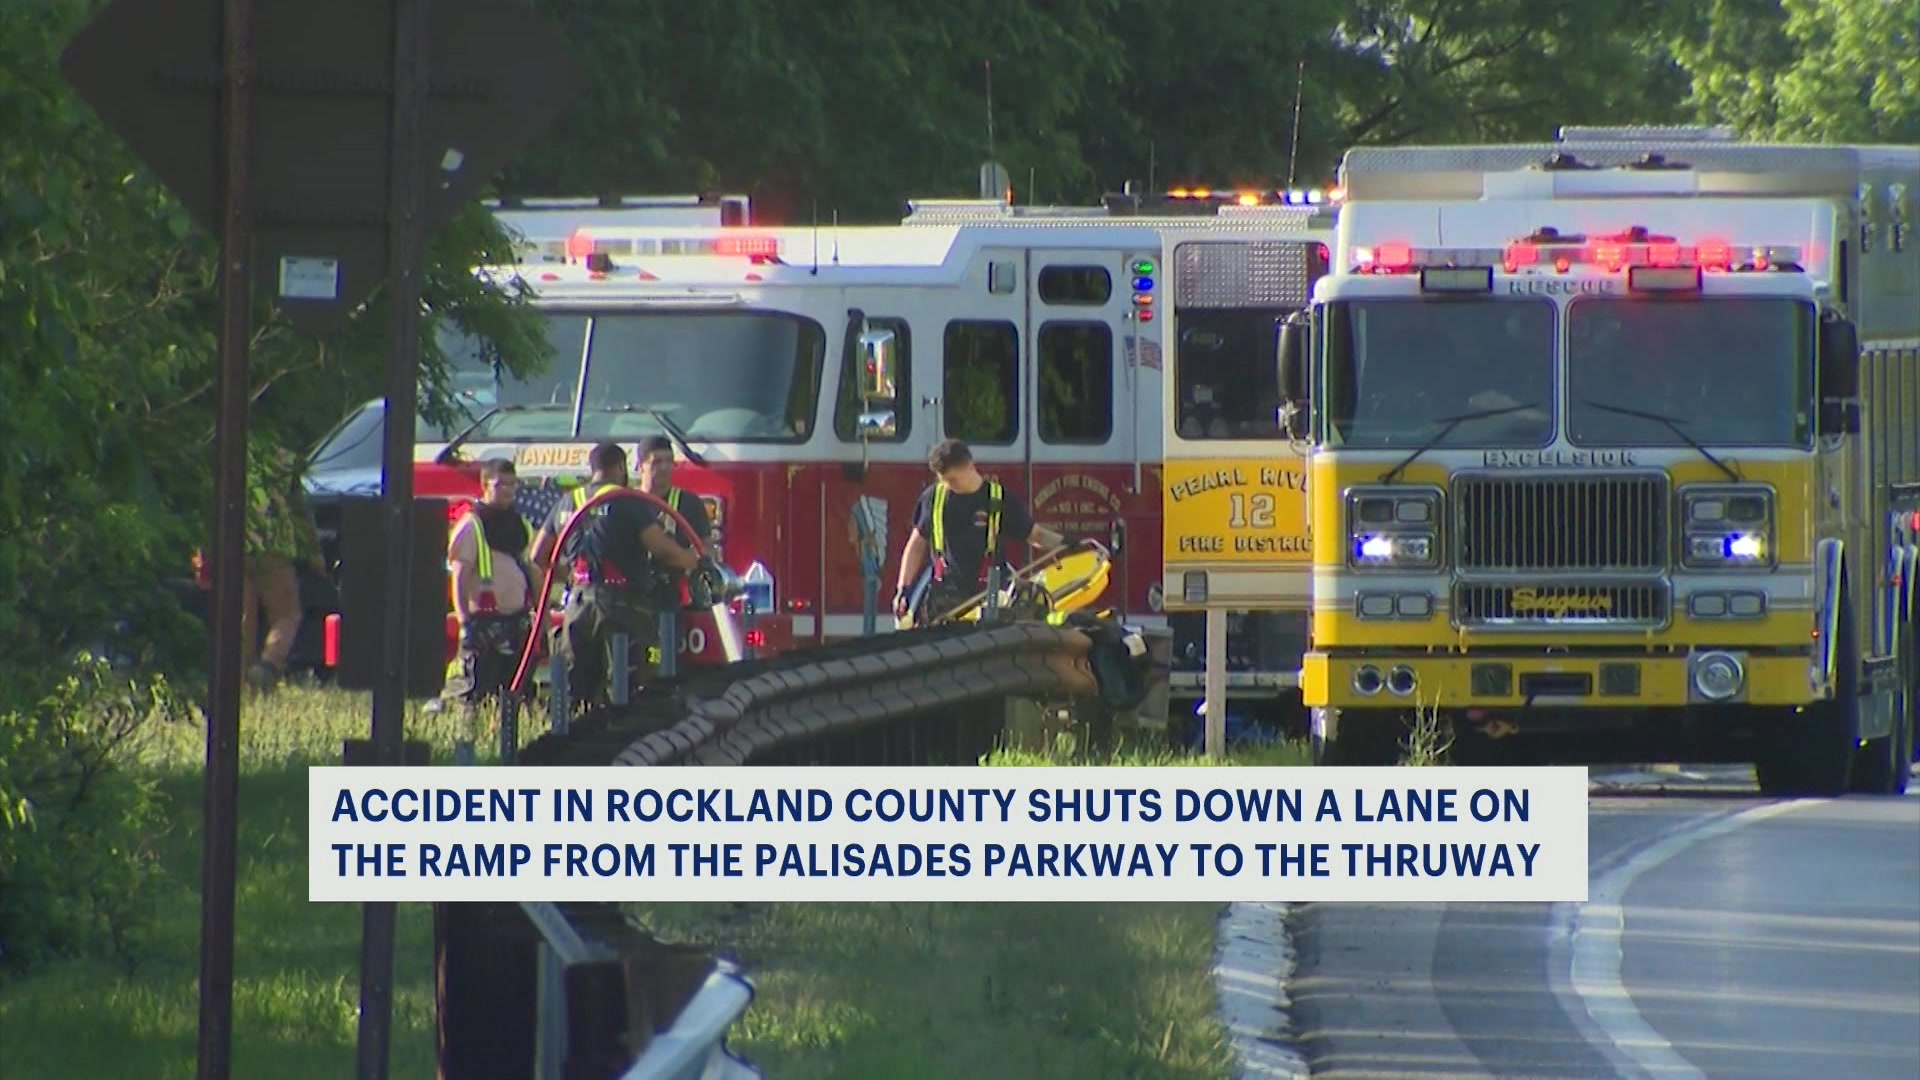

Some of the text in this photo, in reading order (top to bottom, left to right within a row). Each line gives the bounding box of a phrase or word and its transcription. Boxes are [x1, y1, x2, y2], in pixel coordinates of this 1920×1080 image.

[1508, 279, 1615, 295] RESCUE
[1483, 449, 1638, 468] EXCELSIOR
[1170, 467, 1248, 502] PEARL
[1229, 493, 1276, 529] 12
[1178, 535, 1225, 554] FIRE
